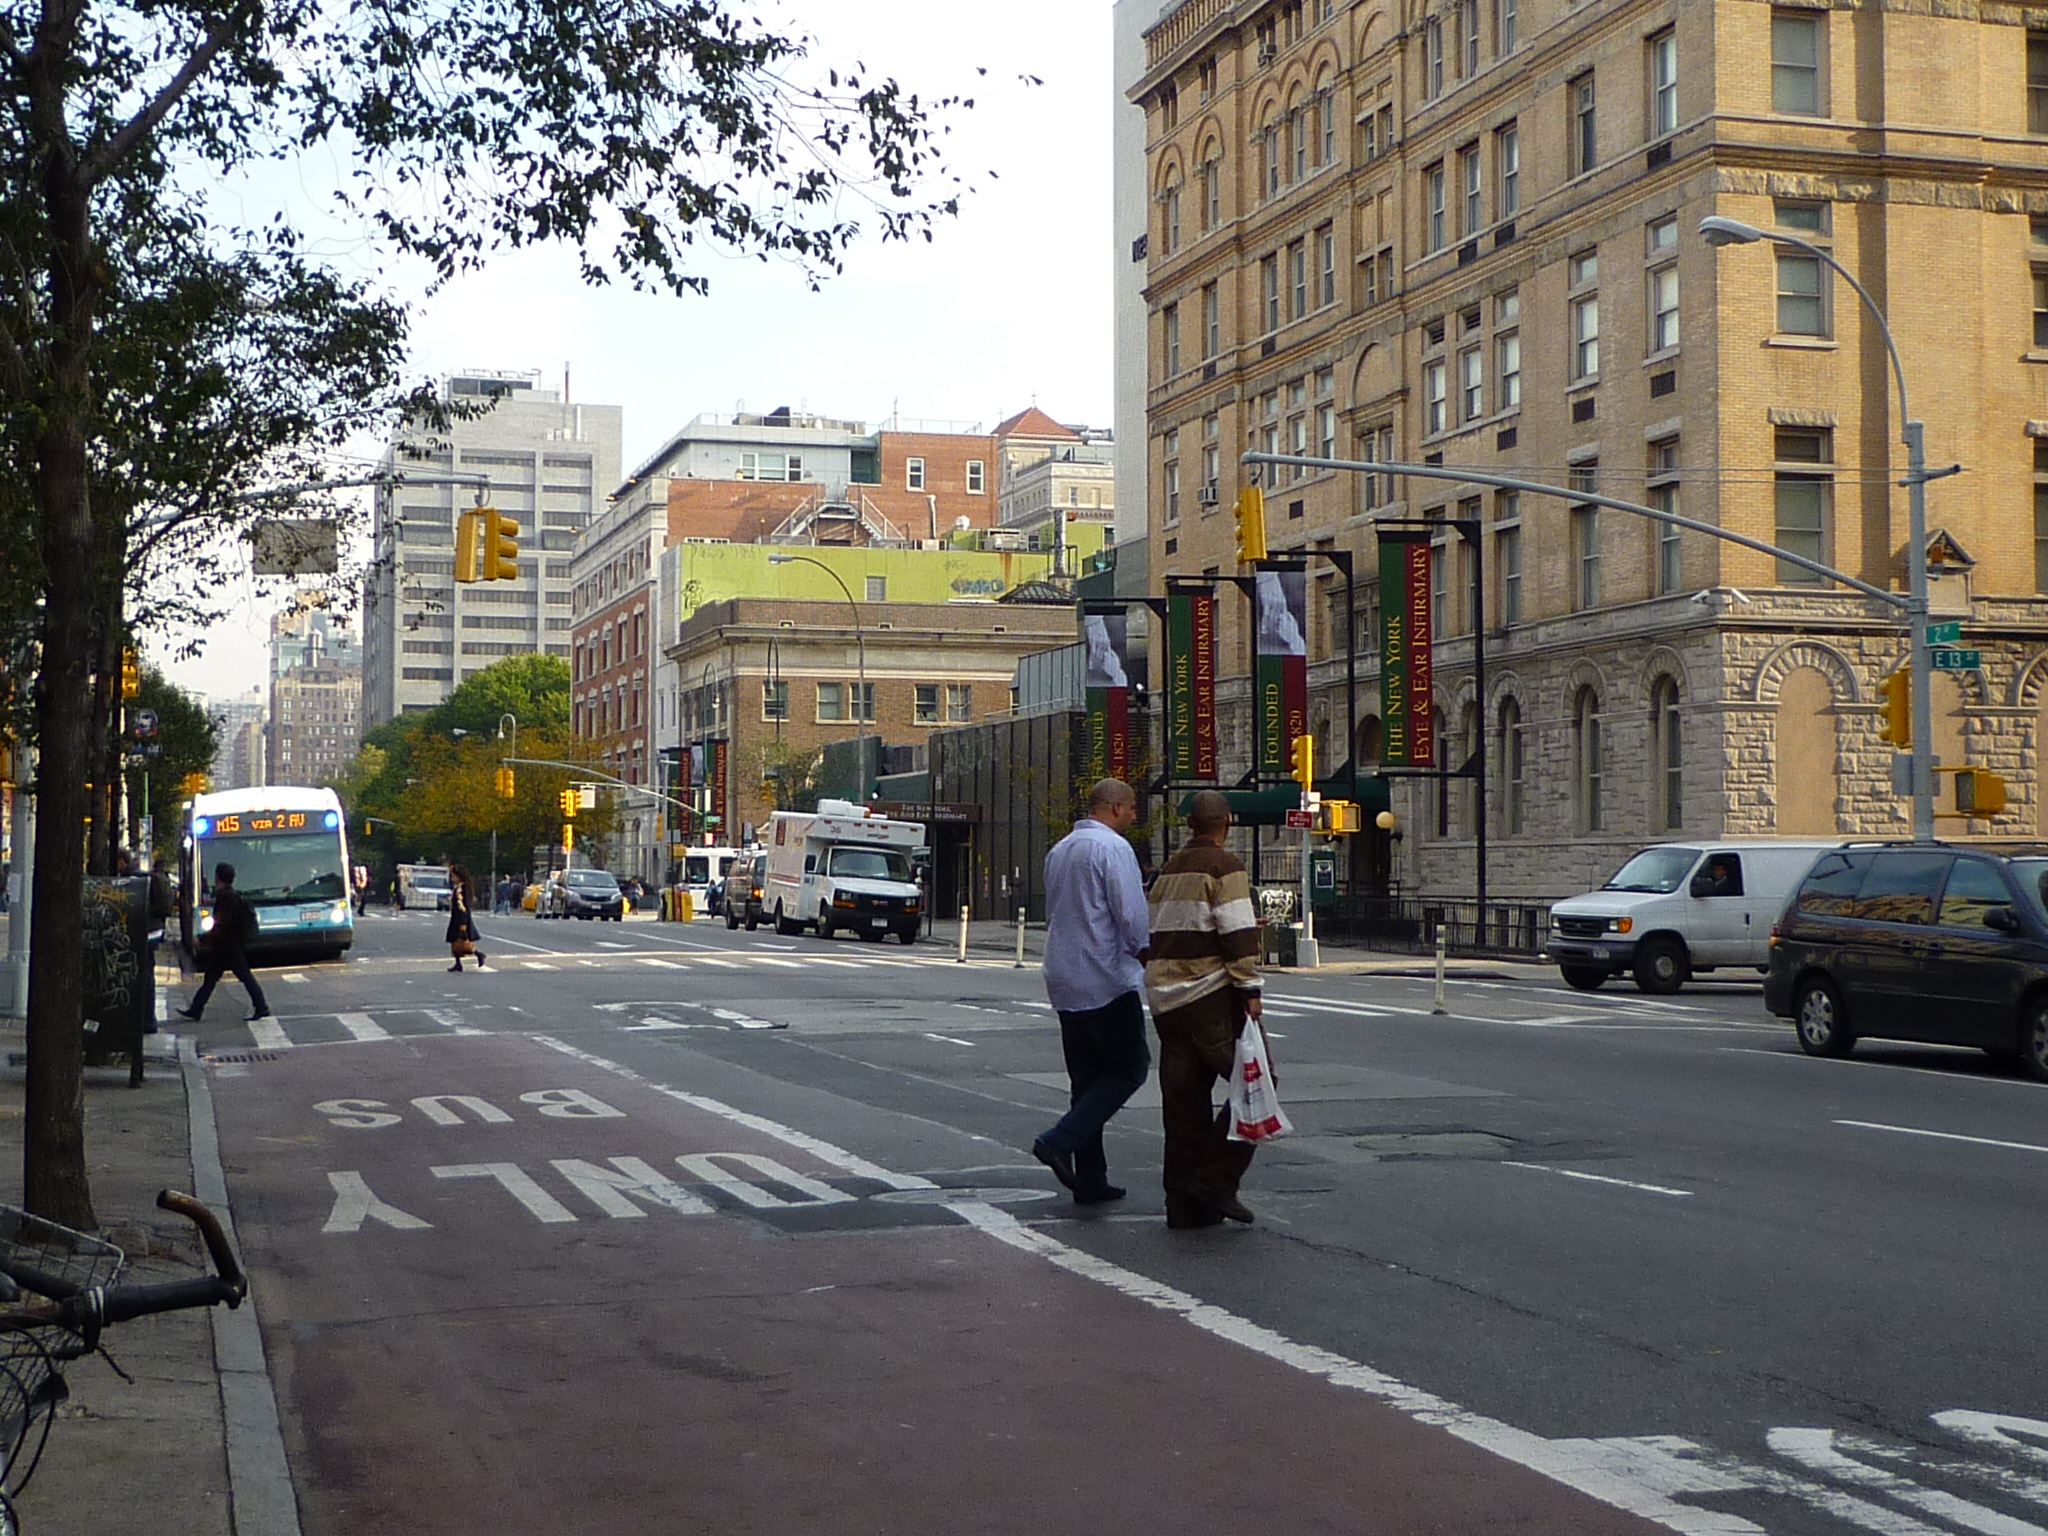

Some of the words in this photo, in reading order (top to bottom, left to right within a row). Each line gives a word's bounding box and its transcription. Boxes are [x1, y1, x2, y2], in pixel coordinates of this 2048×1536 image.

[1412, 546, 1427, 647] INFIRMARY
[1197, 597, 1210, 681] INFIRMARY
[1386, 615, 1401, 666] YORK
[1934, 627, 1941, 642] 2
[1175, 654, 1188, 694] YORK
[1413, 654, 1428, 691] EAR
[1936, 652, 1944, 667] E
[1949, 652, 1961, 667] 13
[1198, 685, 1211, 717] EAR
[1387, 672, 1402, 716] NEW
[1413, 699, 1428, 715] &
[1175, 702, 1189, 736] NEW
[1198, 724, 1211, 737] &
[1265, 683, 1279, 765] FOUNDED
[1114, 733, 1124, 760] 1820
[1176, 743, 1189, 773] THE
[1199, 741, 1212, 773] EYE
[1388, 722, 1403, 760] THE
[1414, 721, 1429, 759] EYE
[216, 815, 240, 832] M15
[251, 819, 273, 829] VIA
[276, 814, 286, 828] 2
[289, 813, 305, 828] AV
[314, 1088, 628, 1129] BUS
[320, 1151, 860, 1233] ONLY
